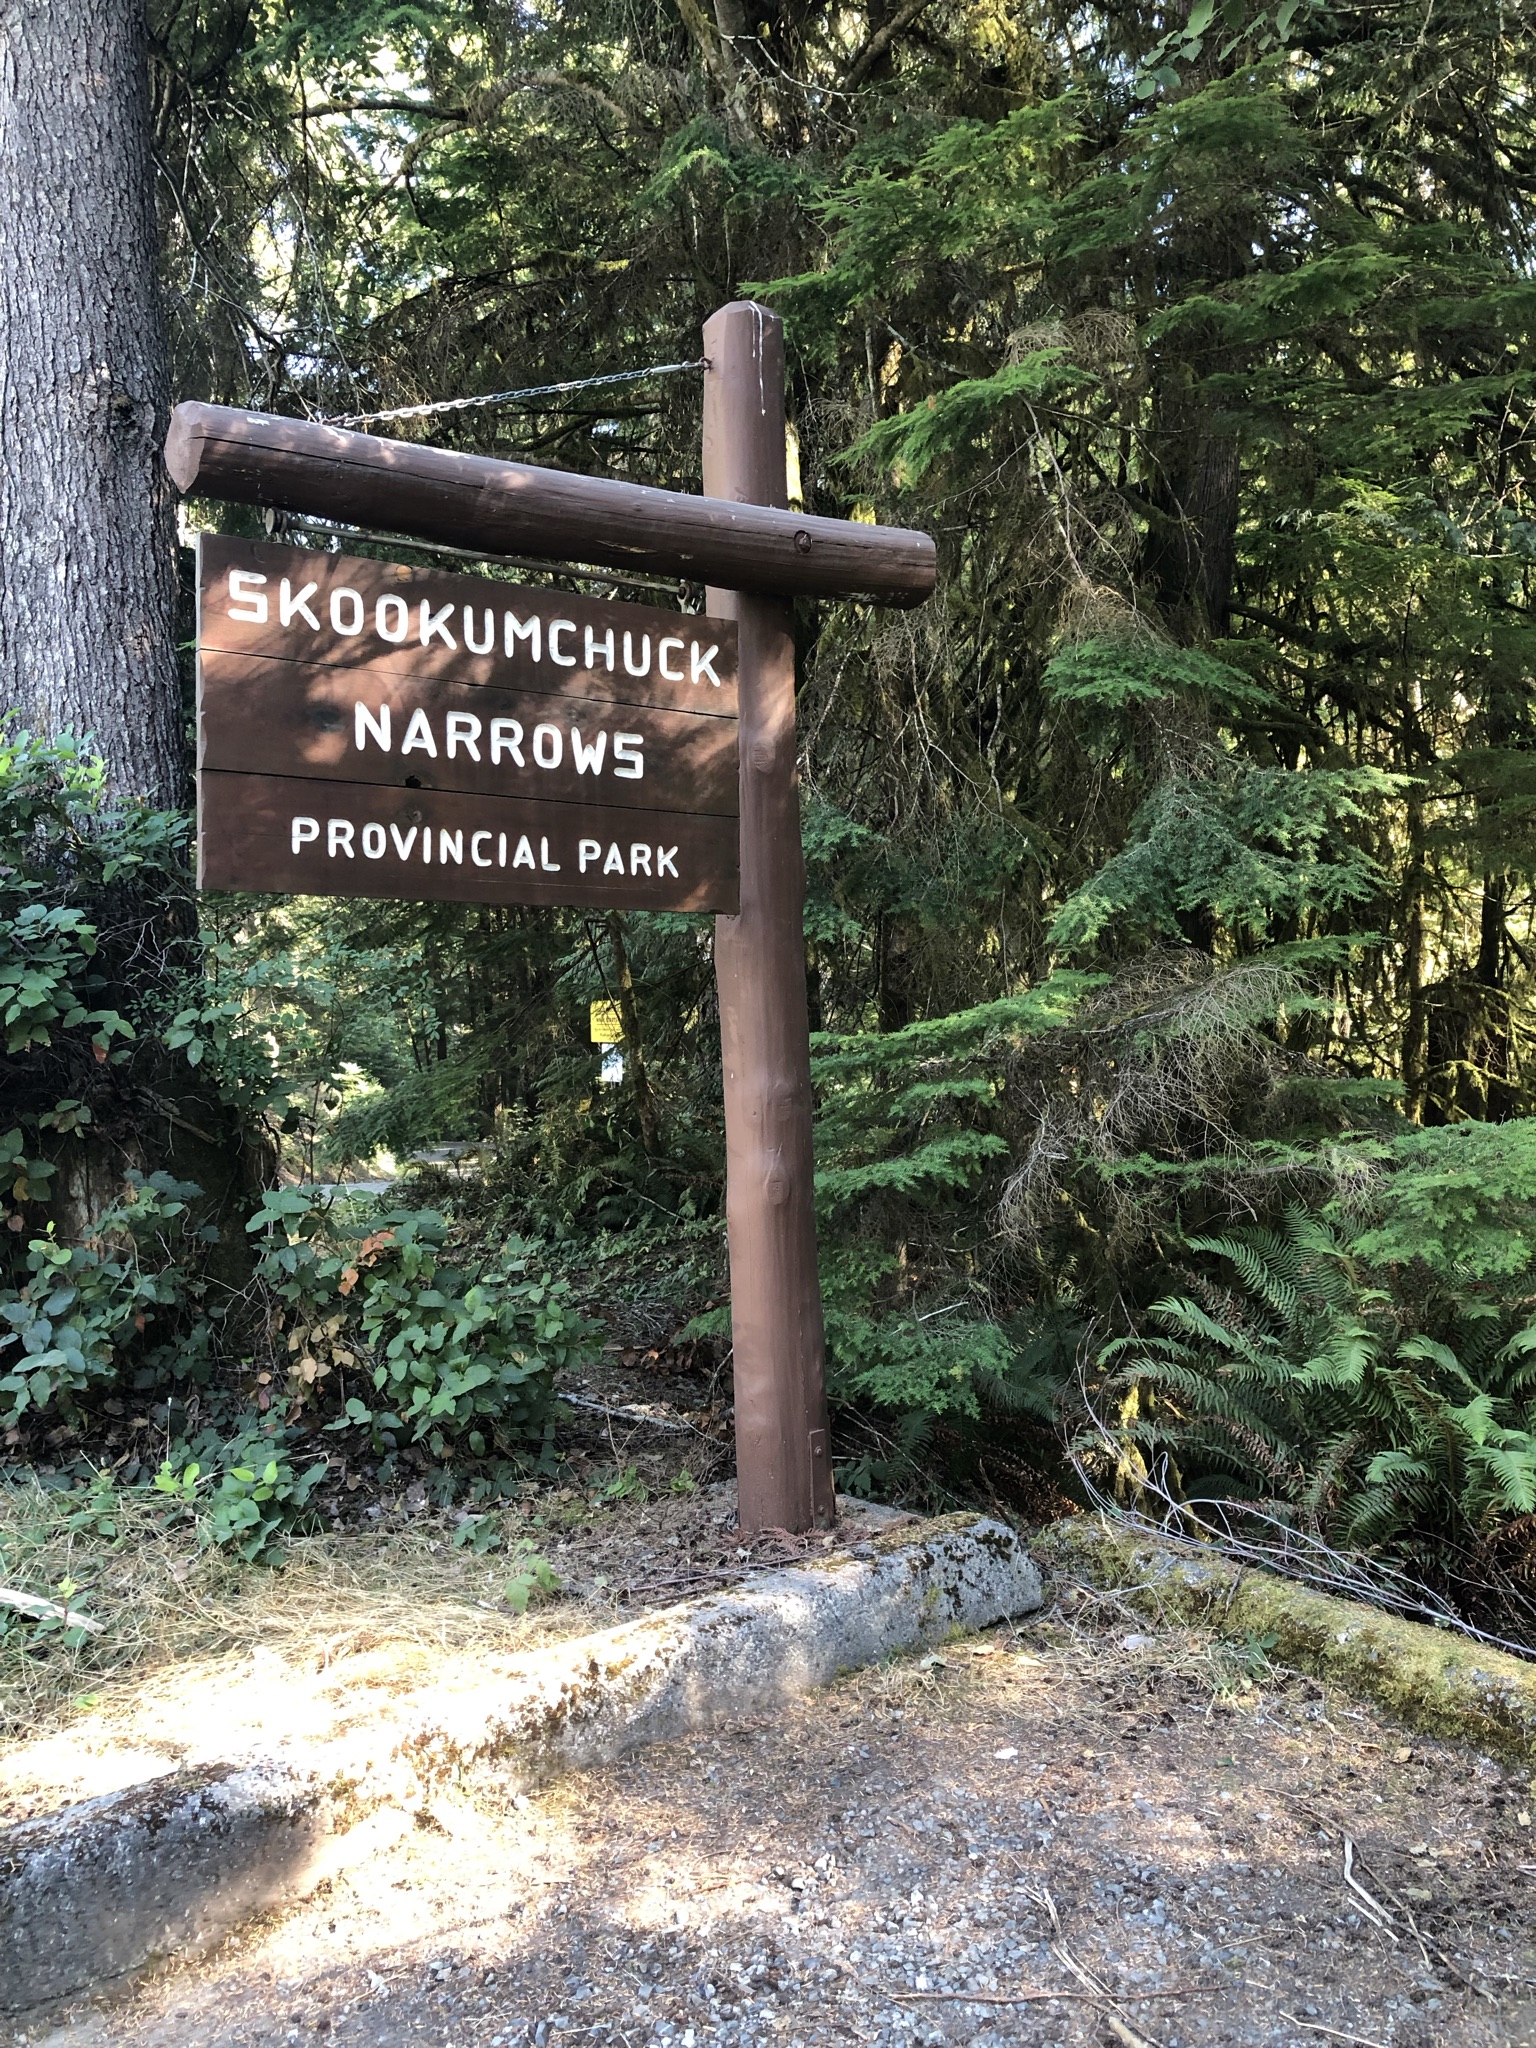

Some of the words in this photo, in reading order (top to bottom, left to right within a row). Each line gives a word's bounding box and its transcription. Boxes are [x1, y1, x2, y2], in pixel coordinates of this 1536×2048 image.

[228, 570, 721, 687] SKOOKUMCHUCK
[355, 701, 644, 780] NARROWS
[291, 816, 560, 872] PROVINCIAL
[579, 838, 679, 878] PARK
